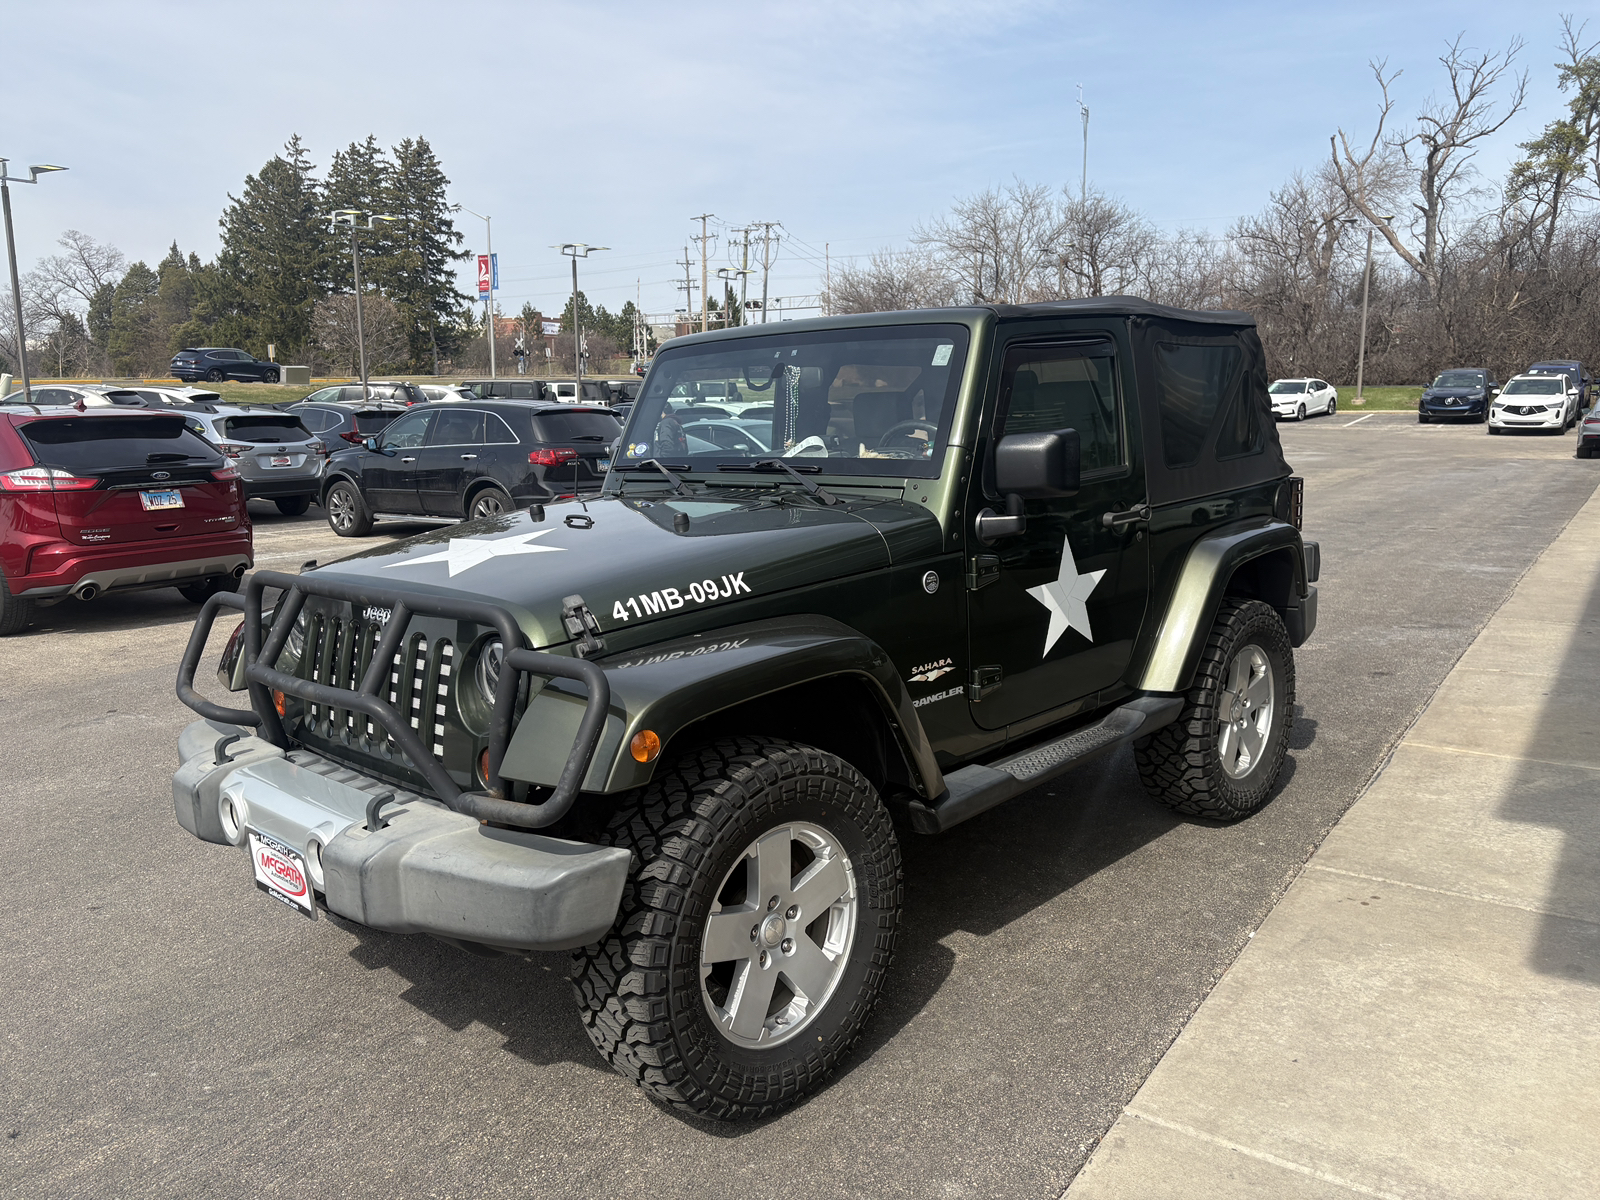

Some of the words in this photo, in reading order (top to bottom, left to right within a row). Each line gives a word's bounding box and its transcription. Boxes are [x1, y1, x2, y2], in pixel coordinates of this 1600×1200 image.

[612, 571, 752, 621] 41MB-09JK
[362, 605, 392, 627] Jeep
[911, 657, 953, 675] SAHARA
[912, 685, 964, 708] RANGLER
